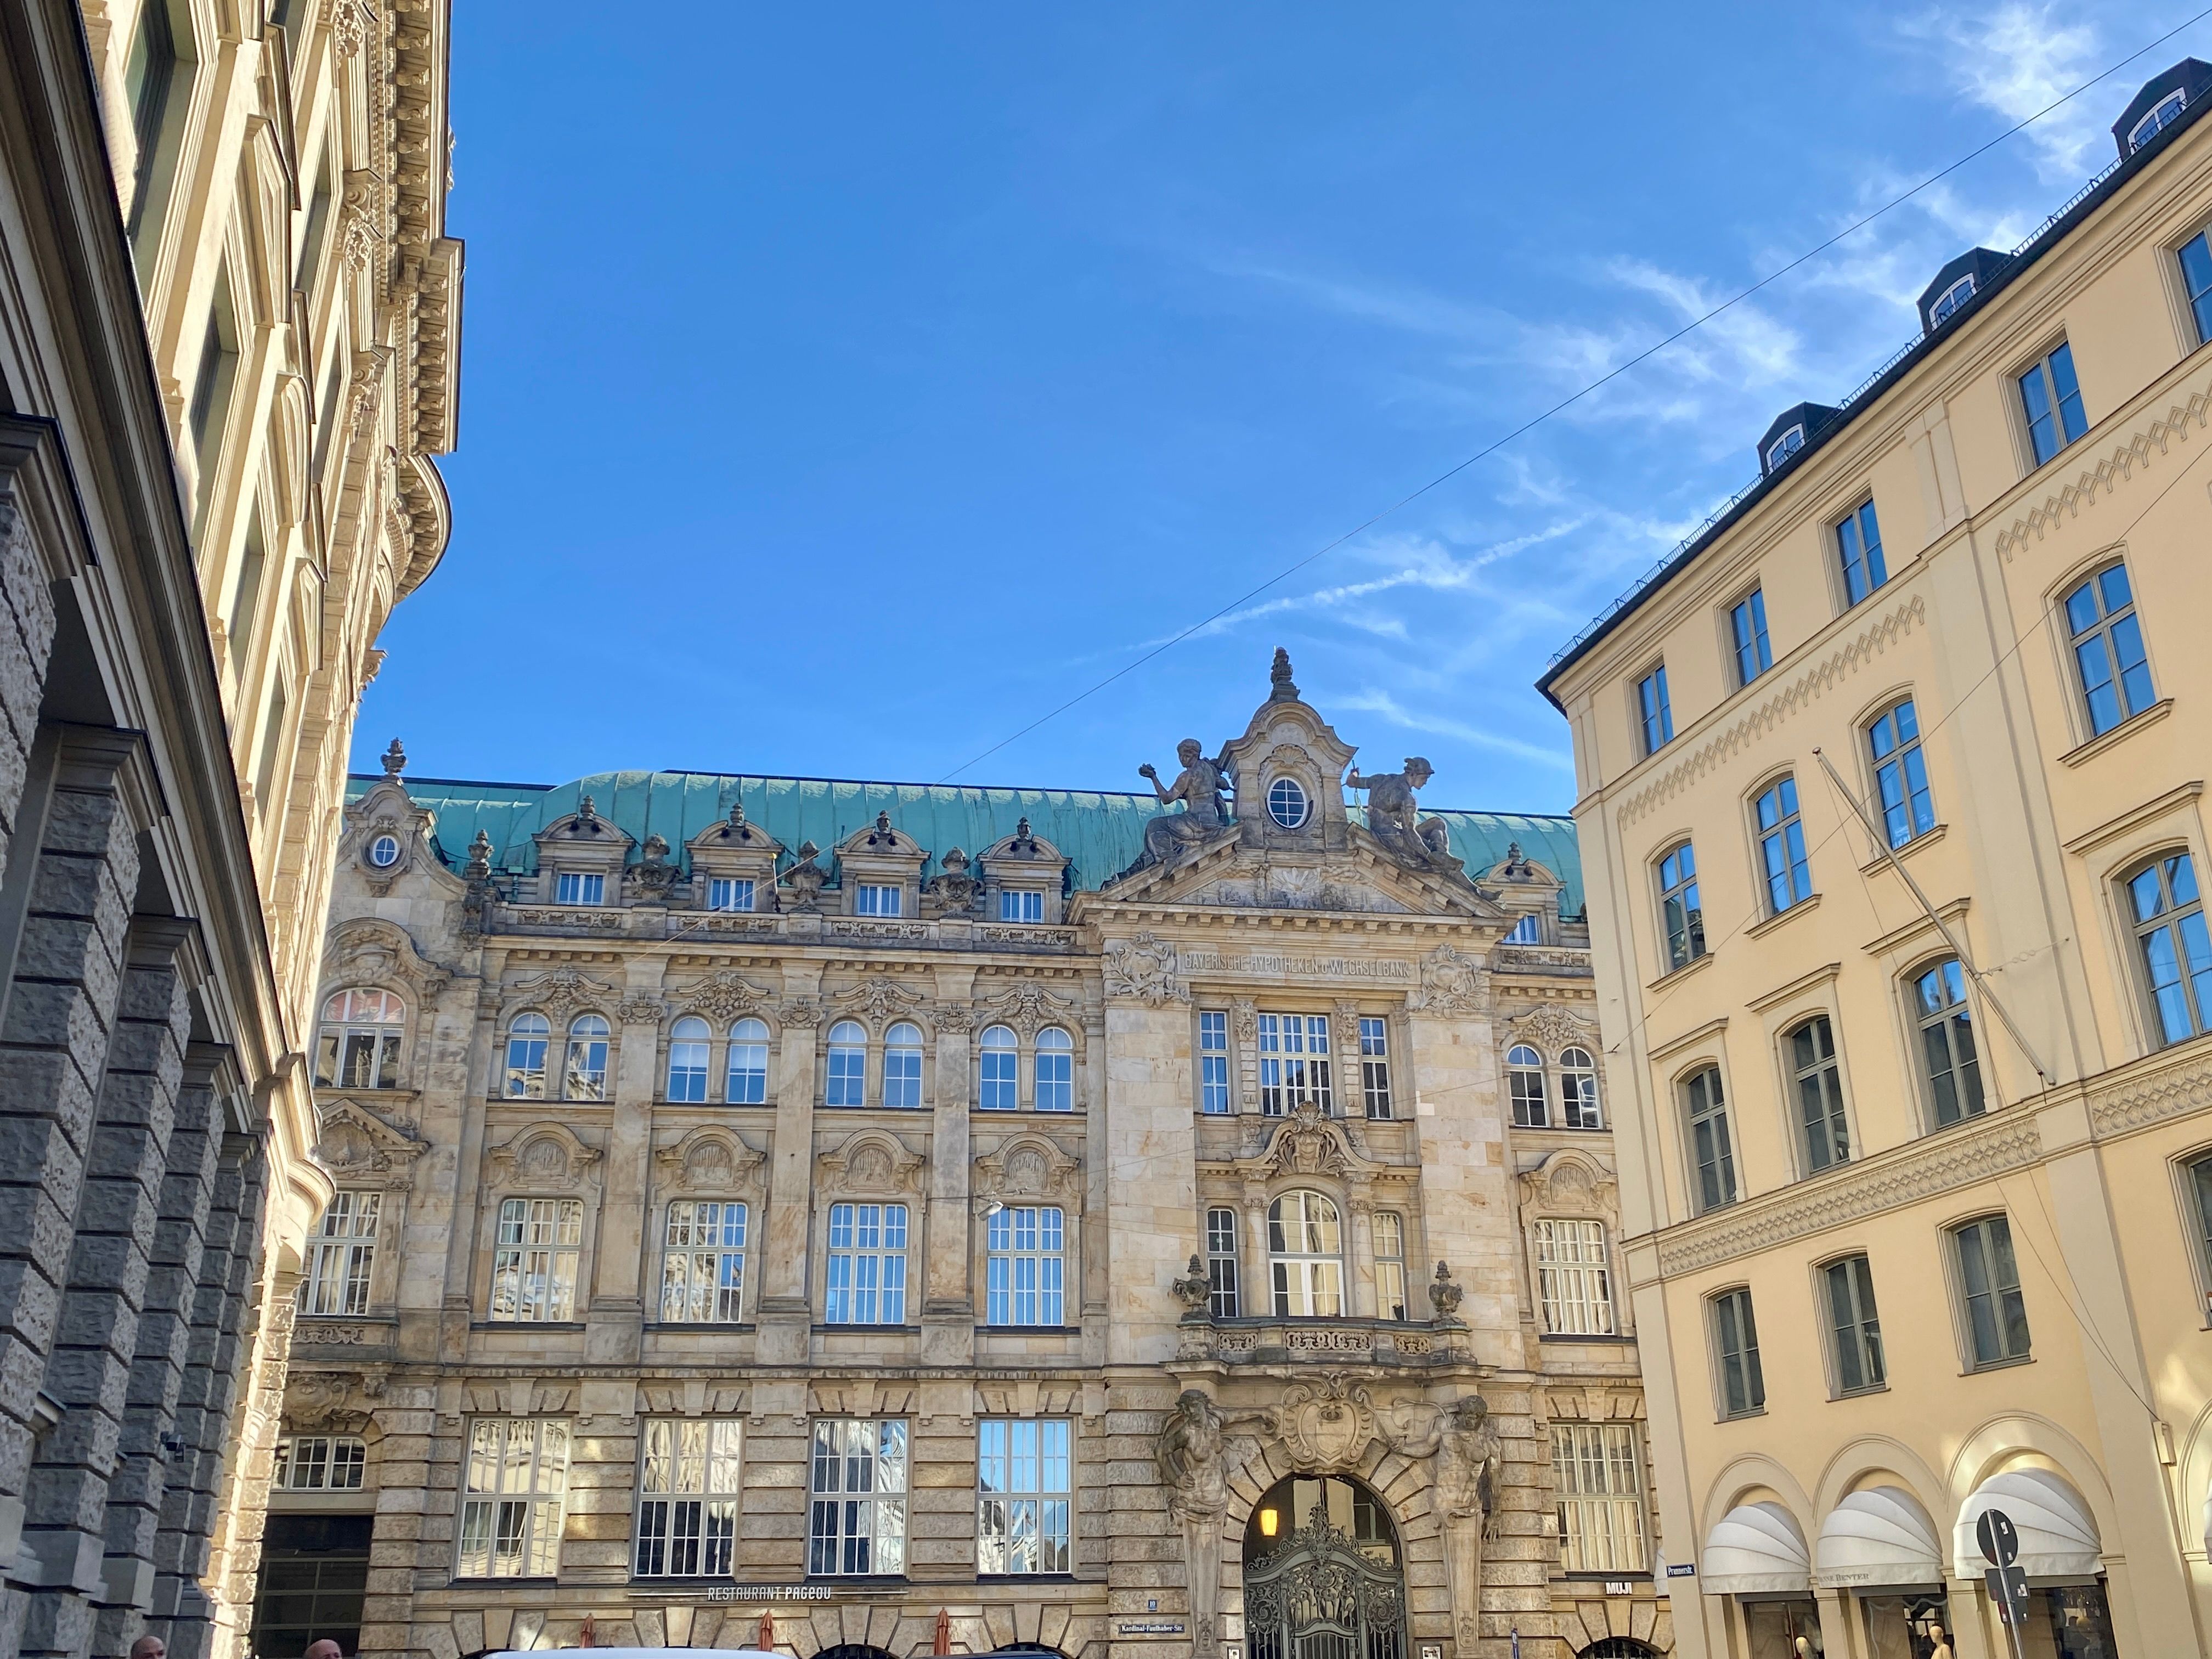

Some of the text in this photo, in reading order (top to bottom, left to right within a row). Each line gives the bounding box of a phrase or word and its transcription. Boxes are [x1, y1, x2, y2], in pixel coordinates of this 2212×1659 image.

[1184, 953, 1247, 970] BAYERISCHE
[1250, 956, 1318, 974] HYPOTHEKEN
[1329, 958, 1410, 977] WECHSELBANK
[708, 1587, 781, 1601] RESTAURANT
[1605, 1582, 1633, 1594] MUJI
